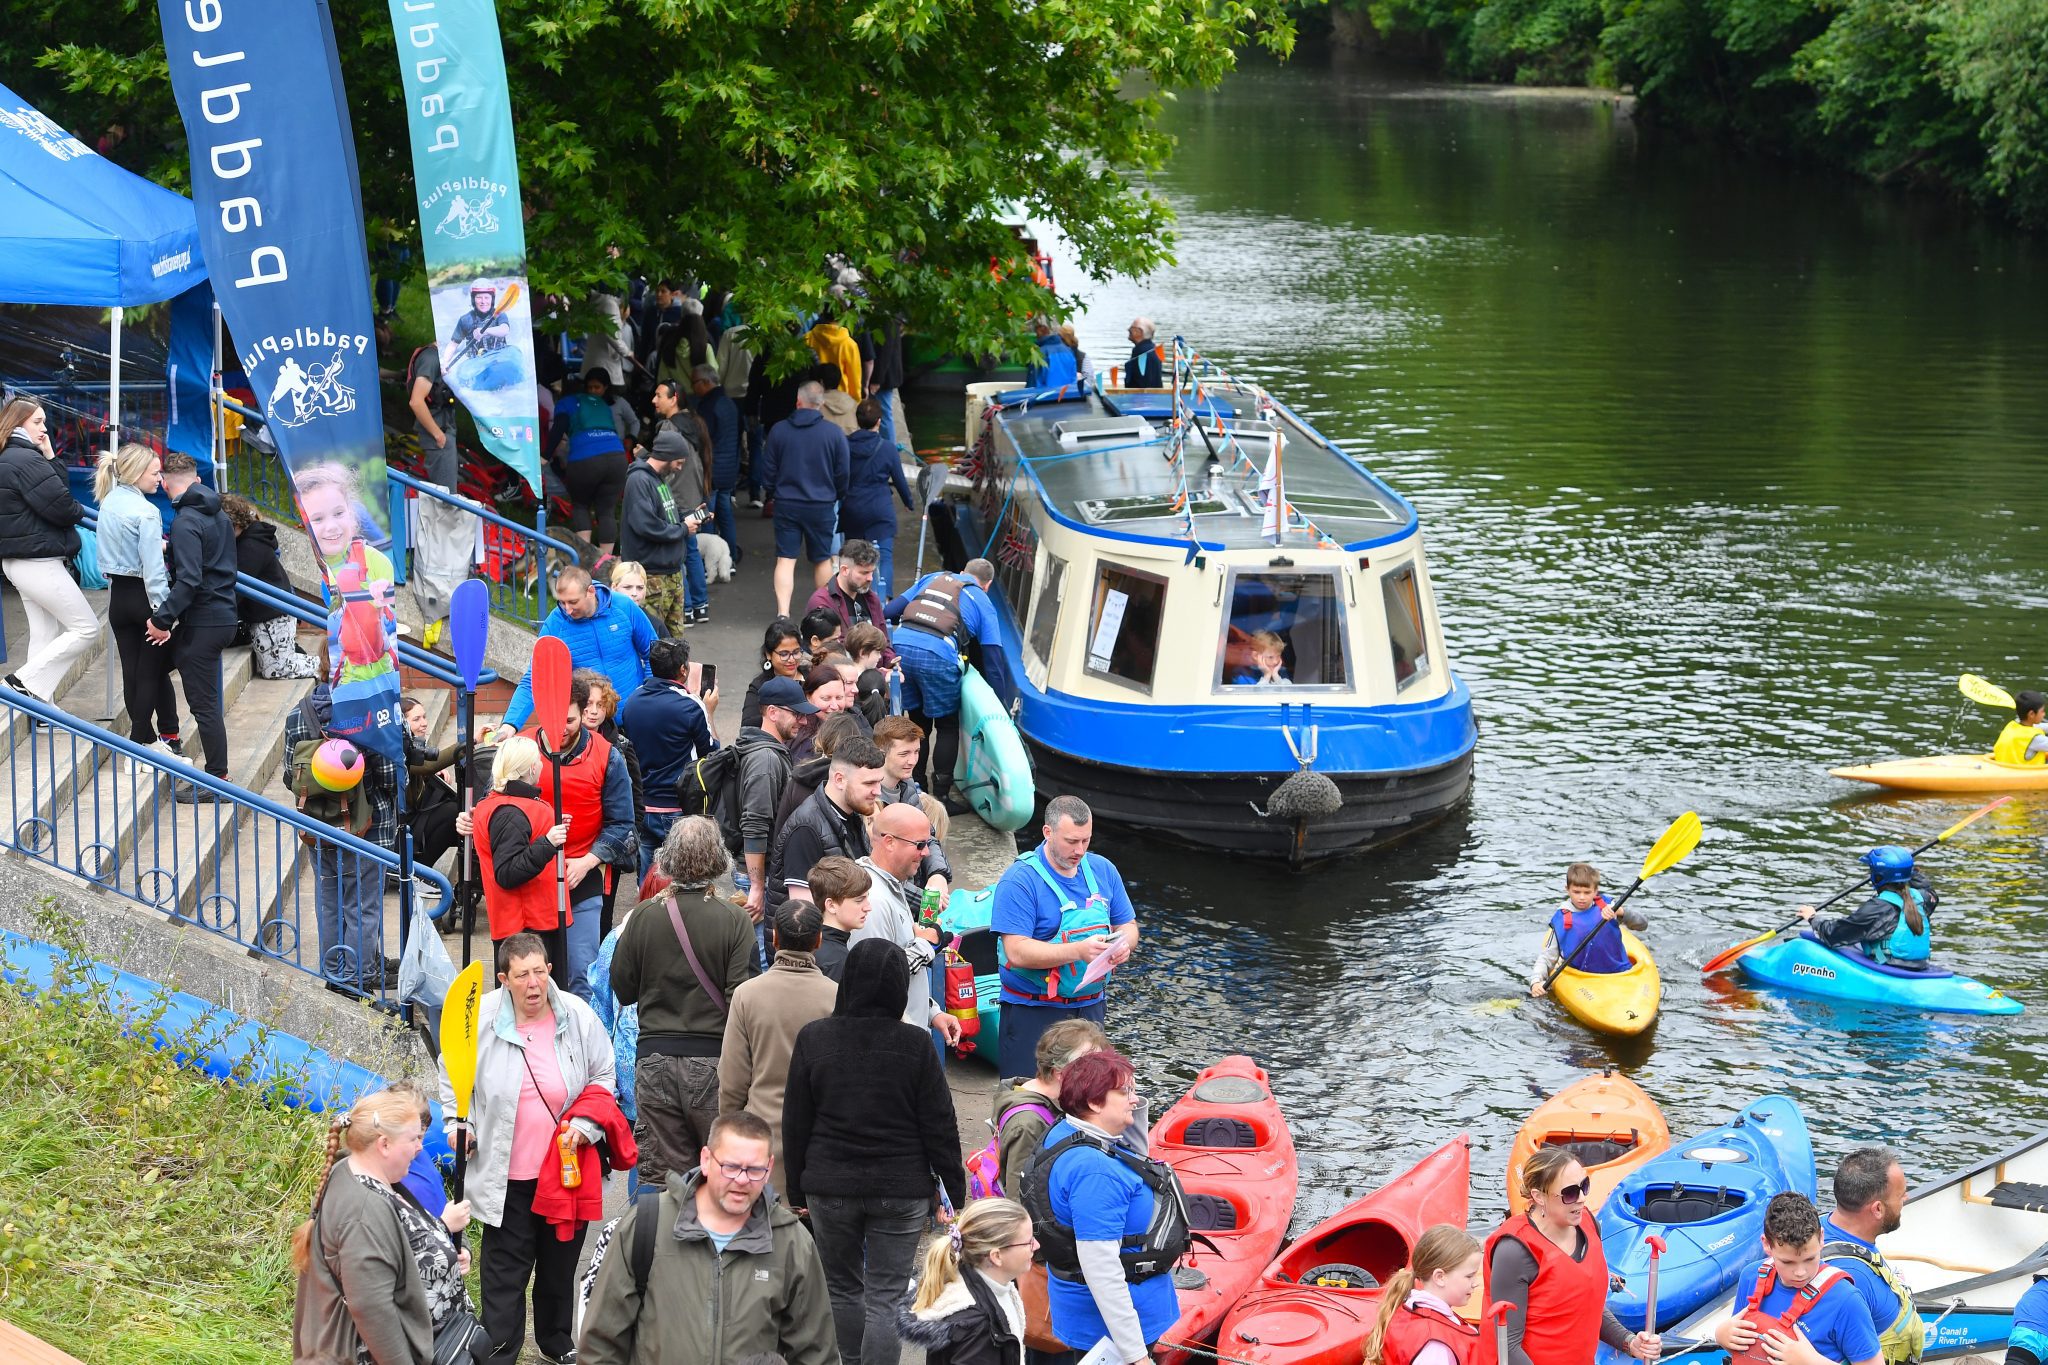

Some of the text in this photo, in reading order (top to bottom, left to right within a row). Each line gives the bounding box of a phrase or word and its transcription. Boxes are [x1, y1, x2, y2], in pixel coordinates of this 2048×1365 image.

[777, 956, 812, 968] Bench
[1792, 962, 1836, 980] pyranha
[1707, 1232, 1736, 1251] Dagger
[1940, 1326, 1969, 1336] Canal &
[1938, 1336, 1978, 1345] River Trust
